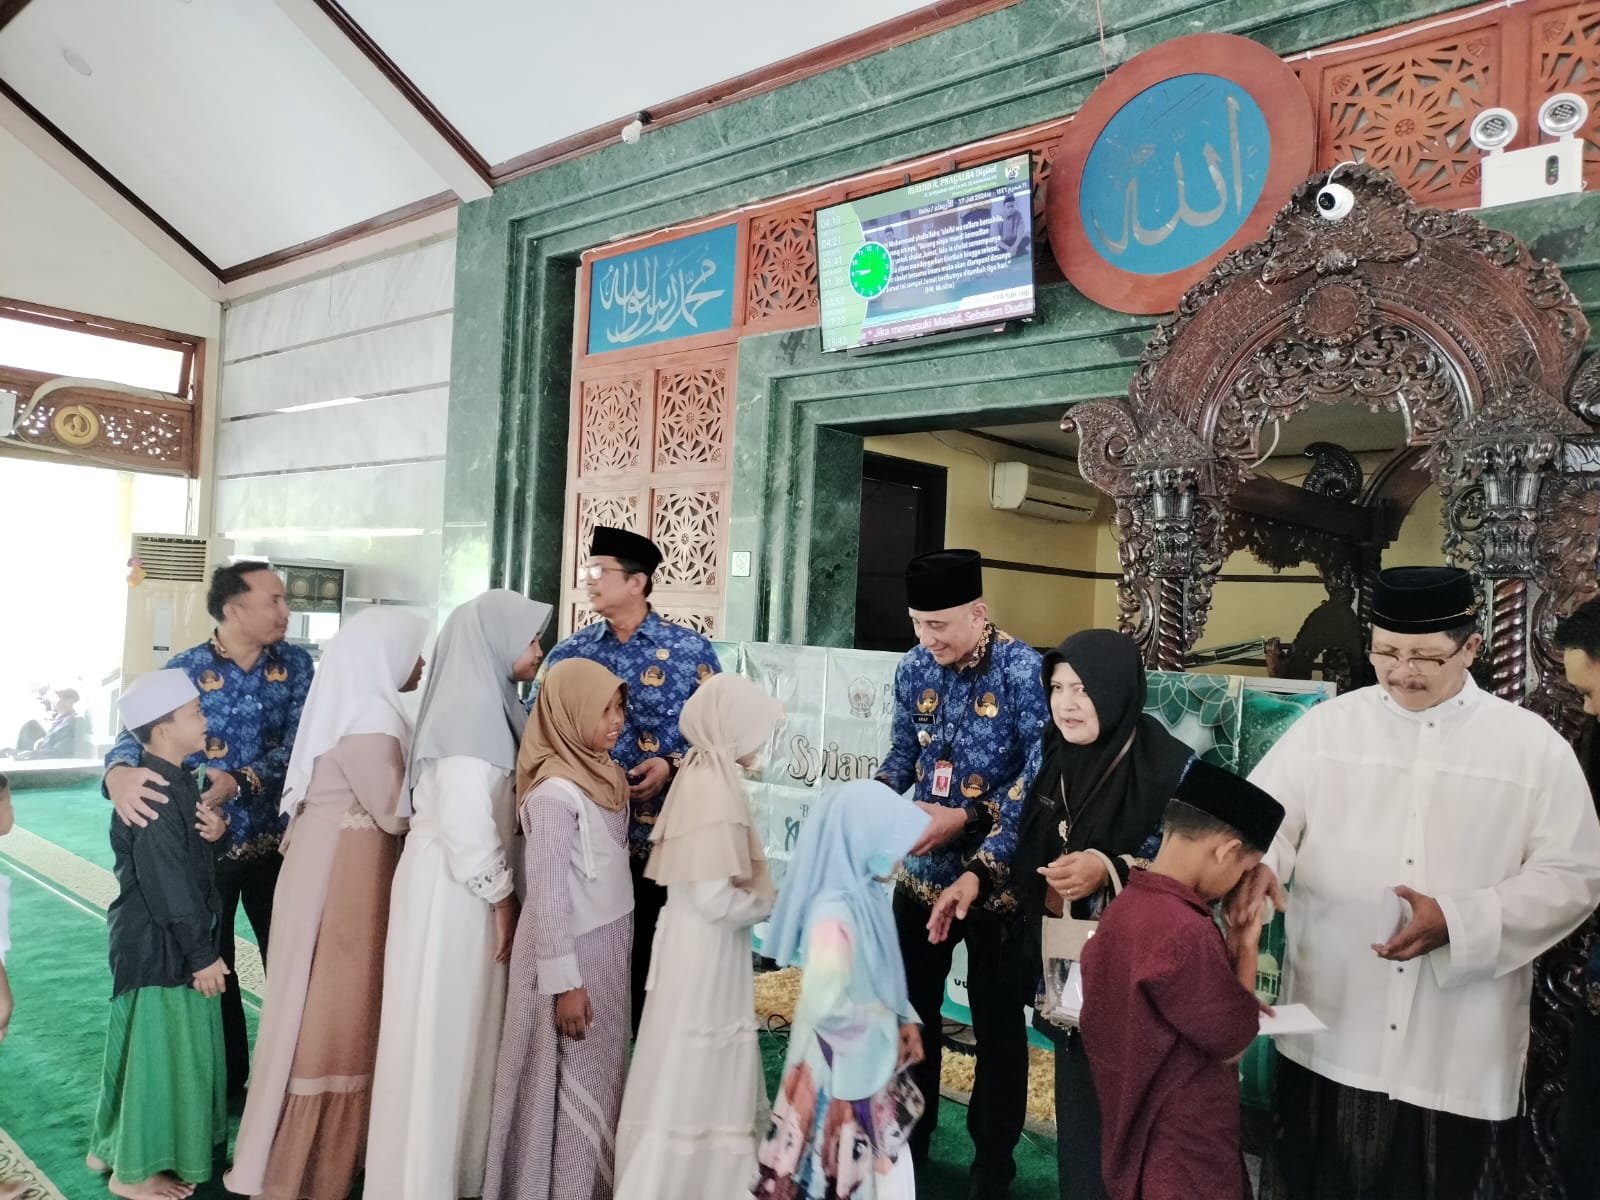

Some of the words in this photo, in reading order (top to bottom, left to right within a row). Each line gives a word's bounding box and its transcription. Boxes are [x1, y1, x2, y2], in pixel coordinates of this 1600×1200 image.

[1091, 94, 1243, 255] الله
[874, 326, 889, 338] Jika
[890, 318, 932, 335] memasuki
